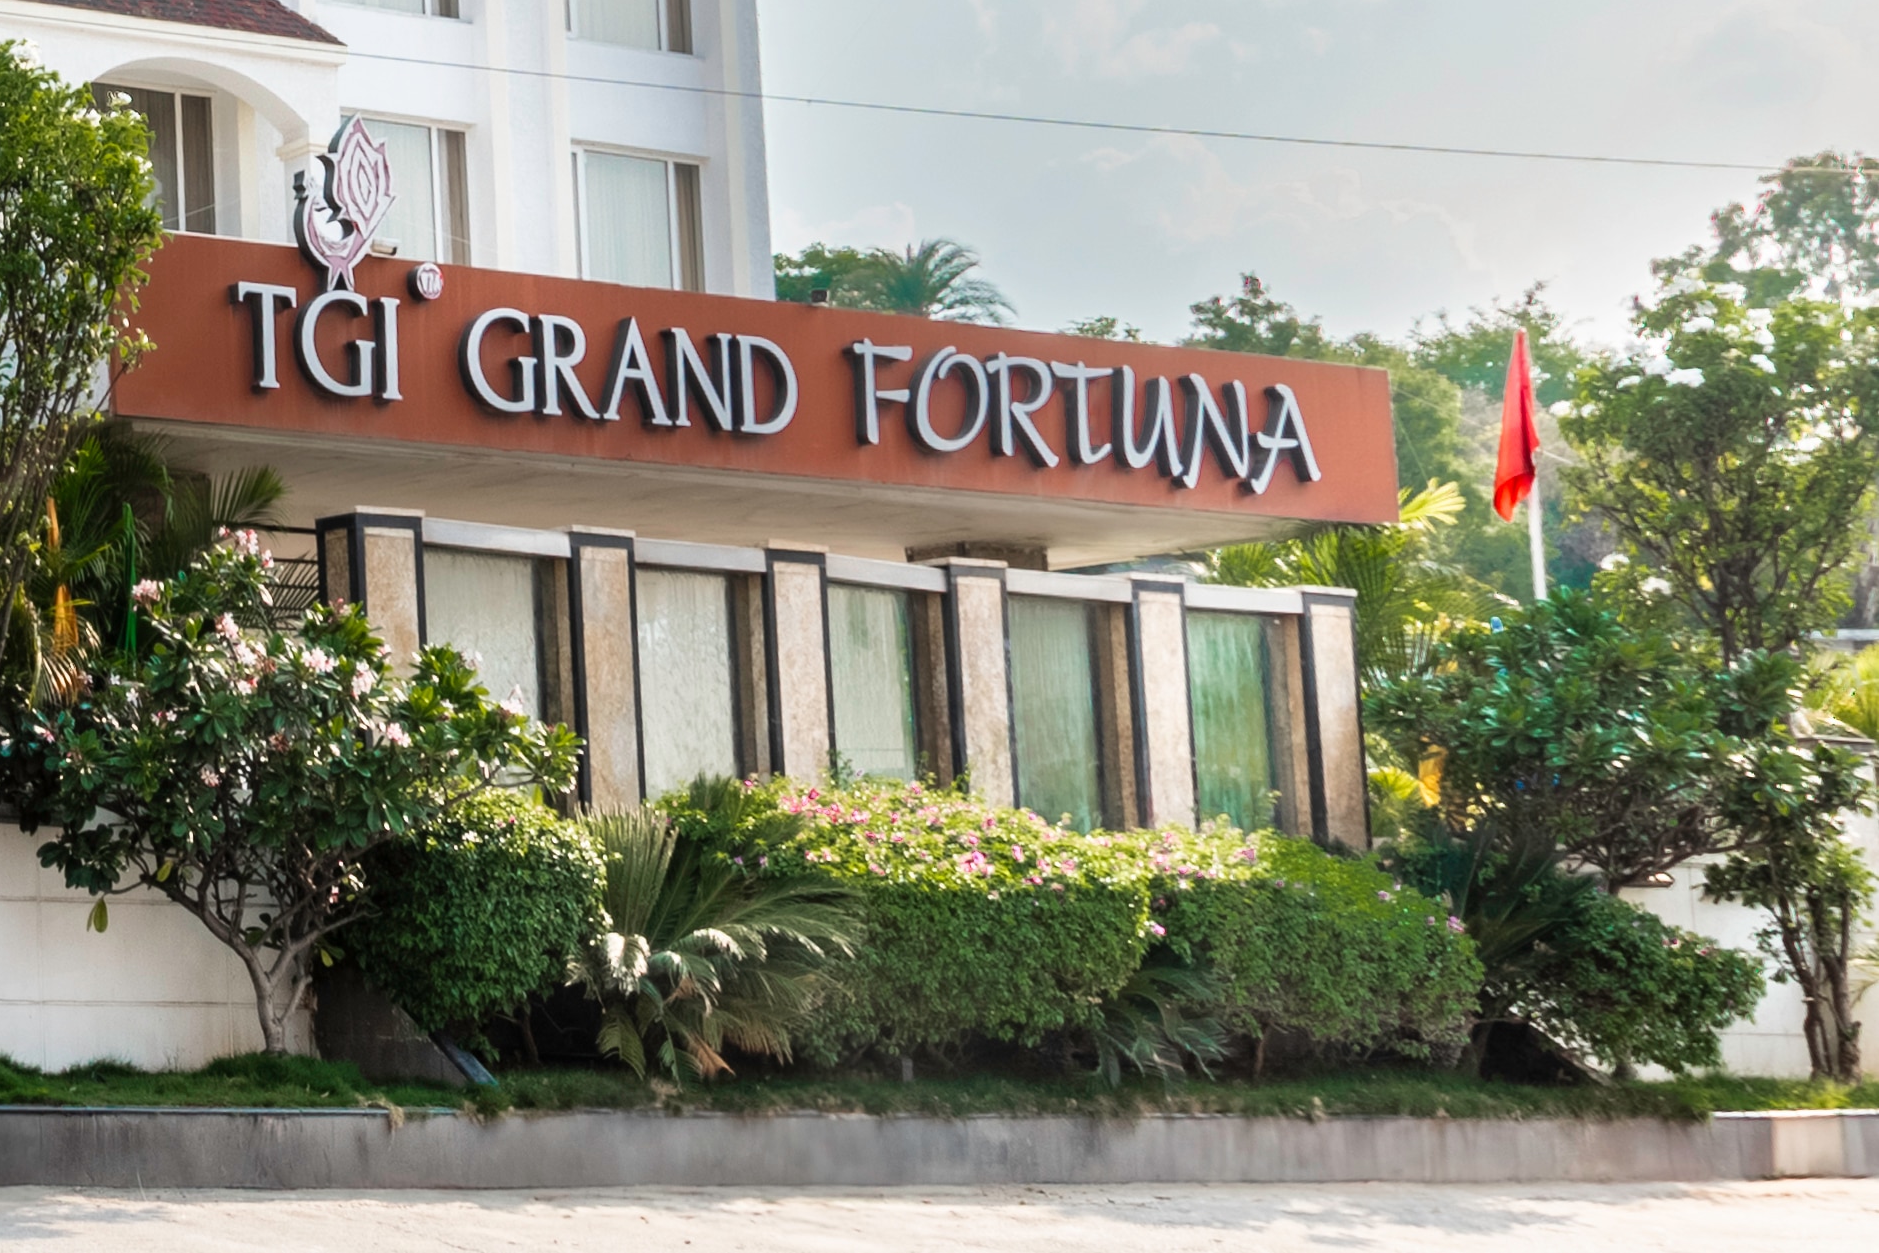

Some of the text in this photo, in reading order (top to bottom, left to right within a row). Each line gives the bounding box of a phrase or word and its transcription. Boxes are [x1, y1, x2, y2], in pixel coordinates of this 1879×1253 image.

[235, 280, 1322, 494] TGI GRAND FORTUNA
